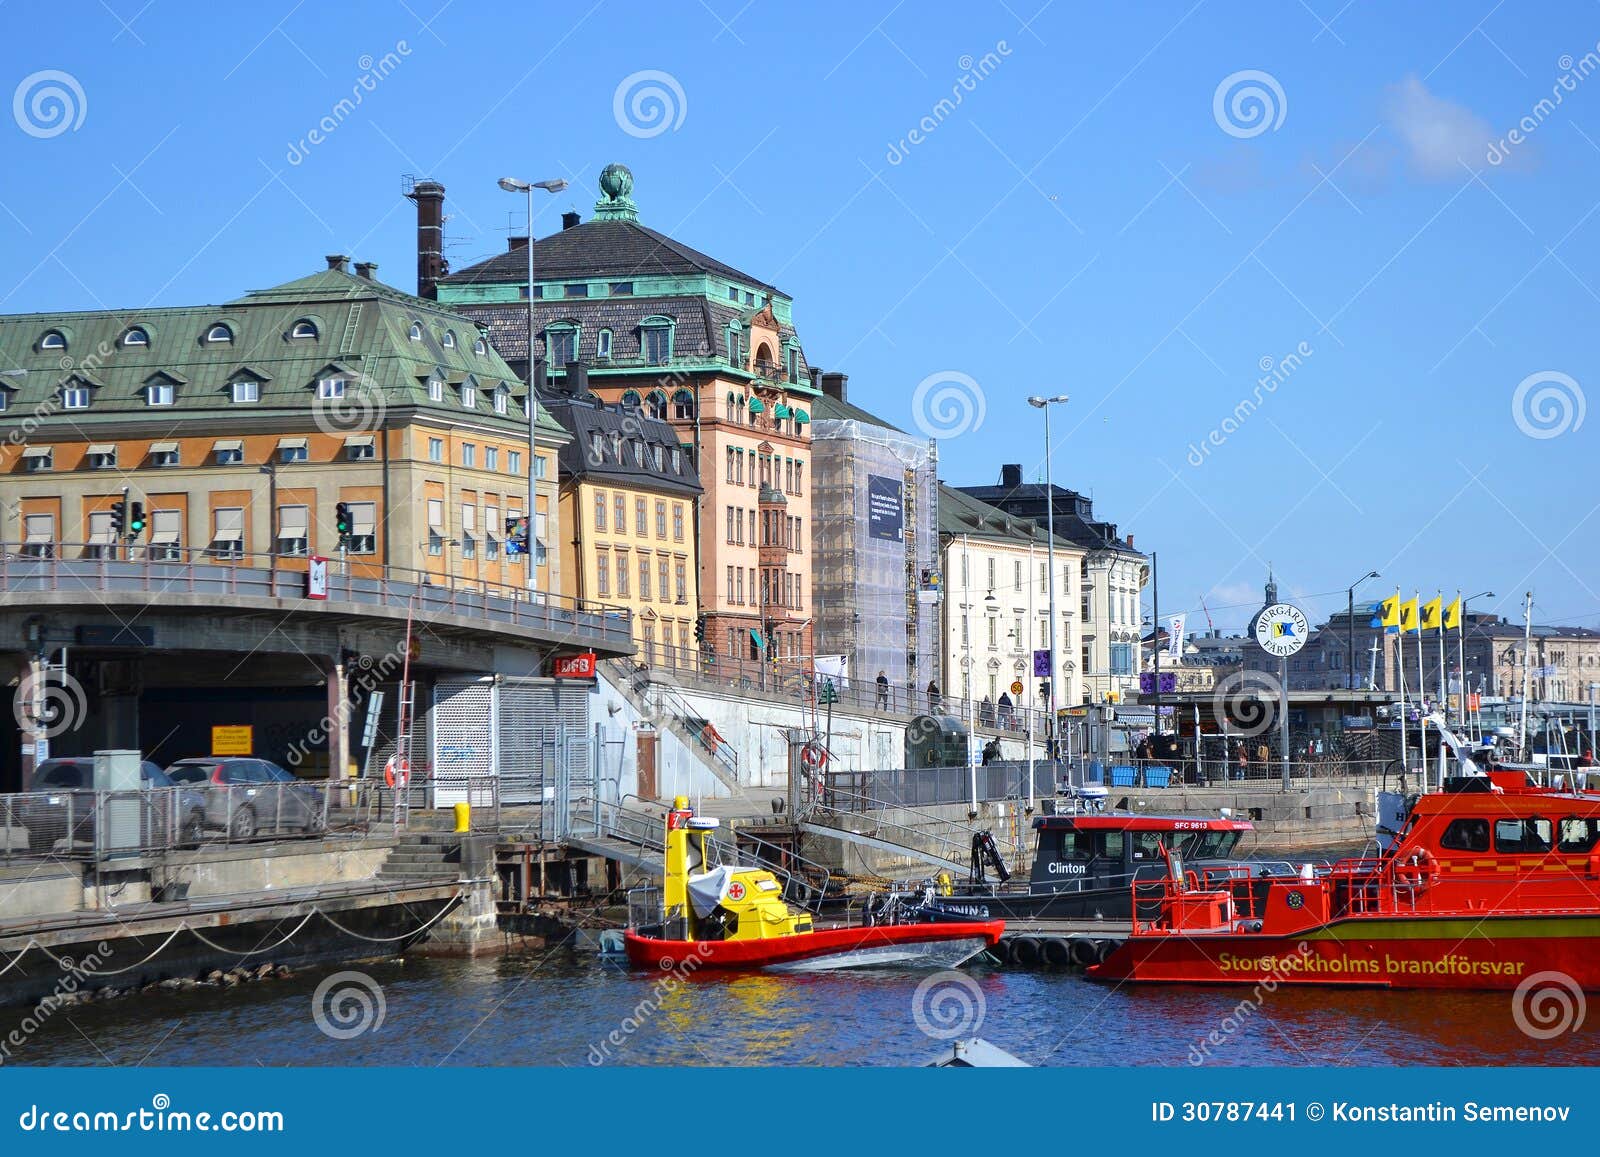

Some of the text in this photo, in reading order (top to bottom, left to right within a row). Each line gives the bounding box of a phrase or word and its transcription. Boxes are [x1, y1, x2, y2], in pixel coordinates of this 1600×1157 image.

[1259, 606, 1306, 633] DJURGÅRDS
[1263, 638, 1302, 656] FÄRJAN
[1048, 862, 1086, 874] Clinton
[1218, 952, 1525, 976] Storstockholms brandförsvar
